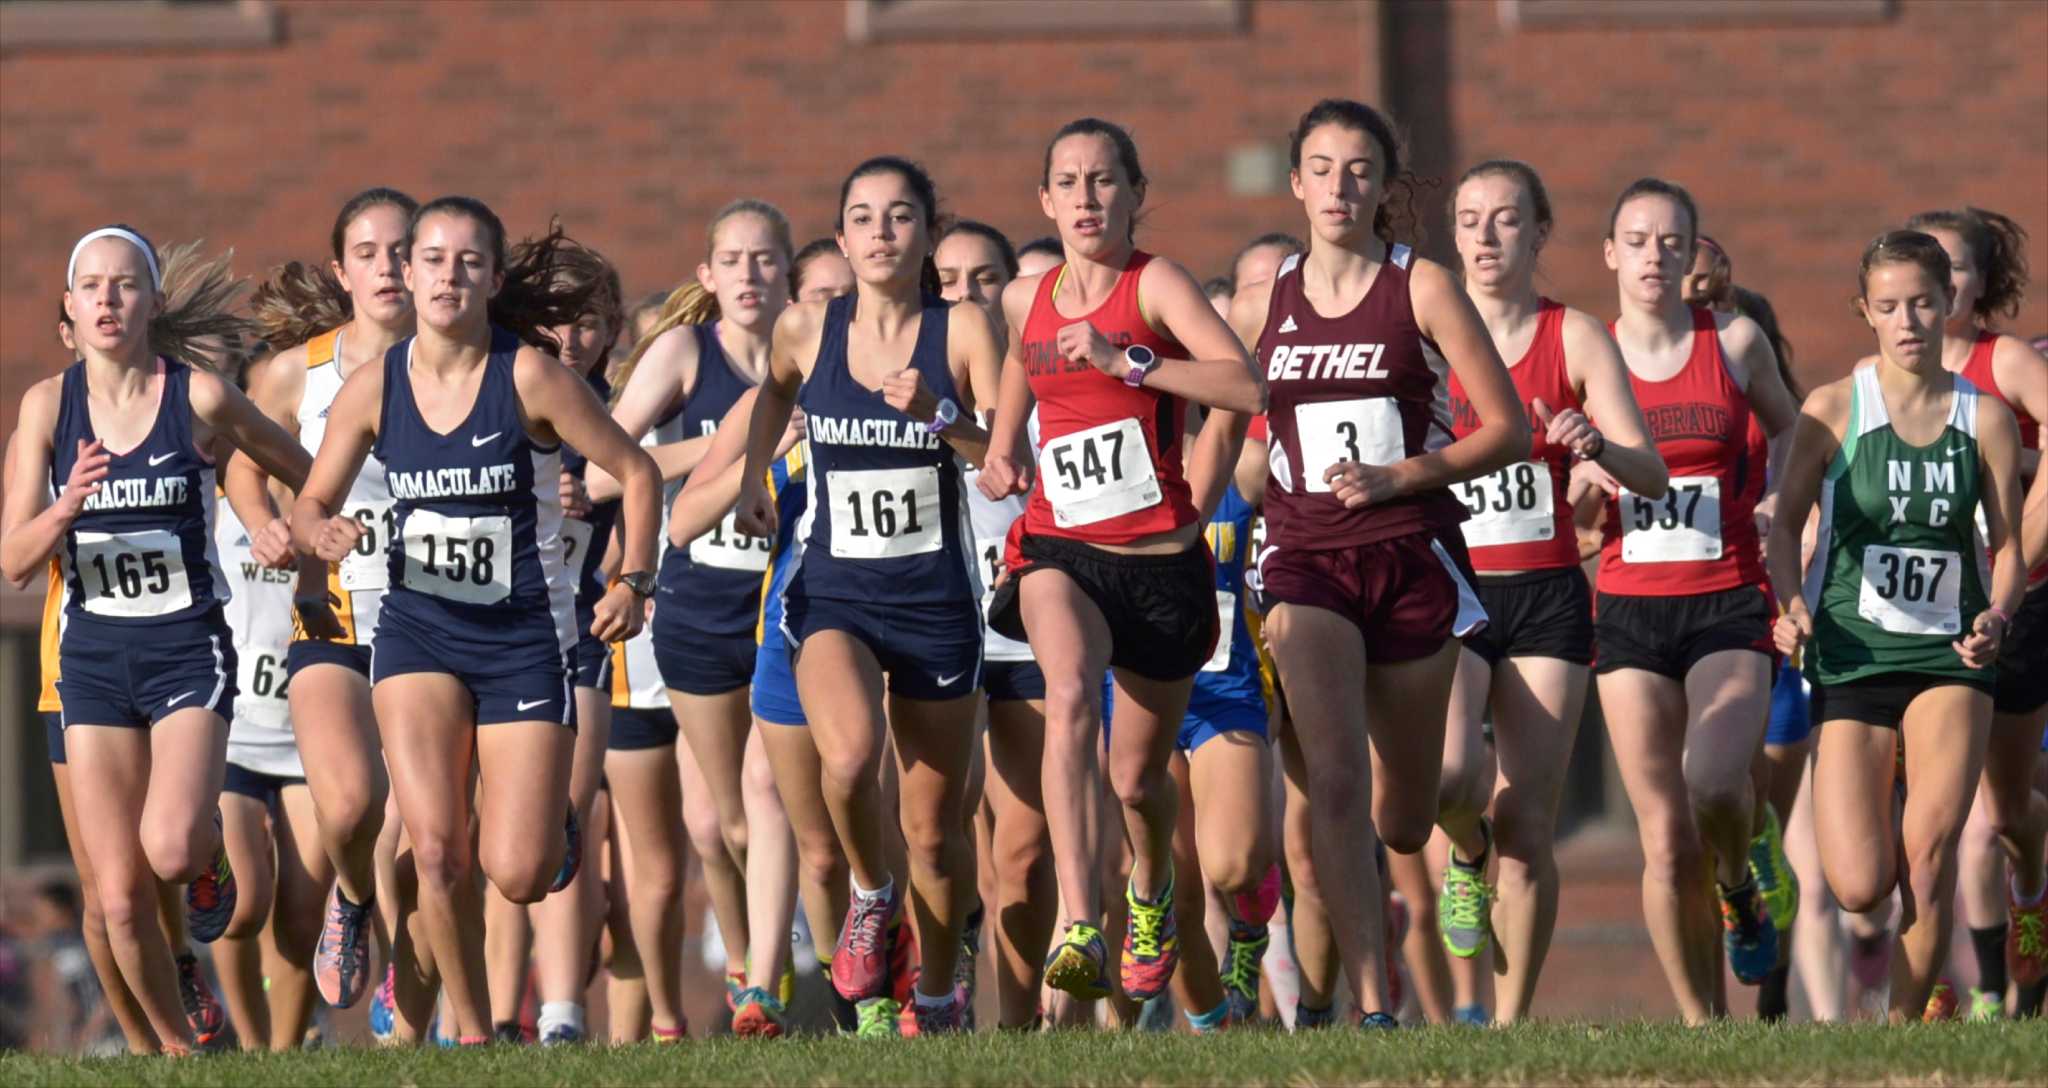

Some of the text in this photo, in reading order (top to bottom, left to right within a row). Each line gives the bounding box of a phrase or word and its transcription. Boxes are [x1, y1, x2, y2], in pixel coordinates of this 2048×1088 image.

[1268, 343, 1389, 380] BETHEL
[811, 415, 941, 450] IMMACULATE
[1335, 421, 1361, 463] 3
[389, 463, 517, 500] IMMACULATE
[1052, 430, 1125, 491] 547
[60, 476, 188, 511] MACULATE
[847, 489, 923, 538] 161
[1464, 464, 1536, 516] 538
[1633, 484, 1703, 532] 537
[92, 550, 170, 599] 165
[421, 533, 495, 586] 158
[1876, 552, 1949, 603] 367
